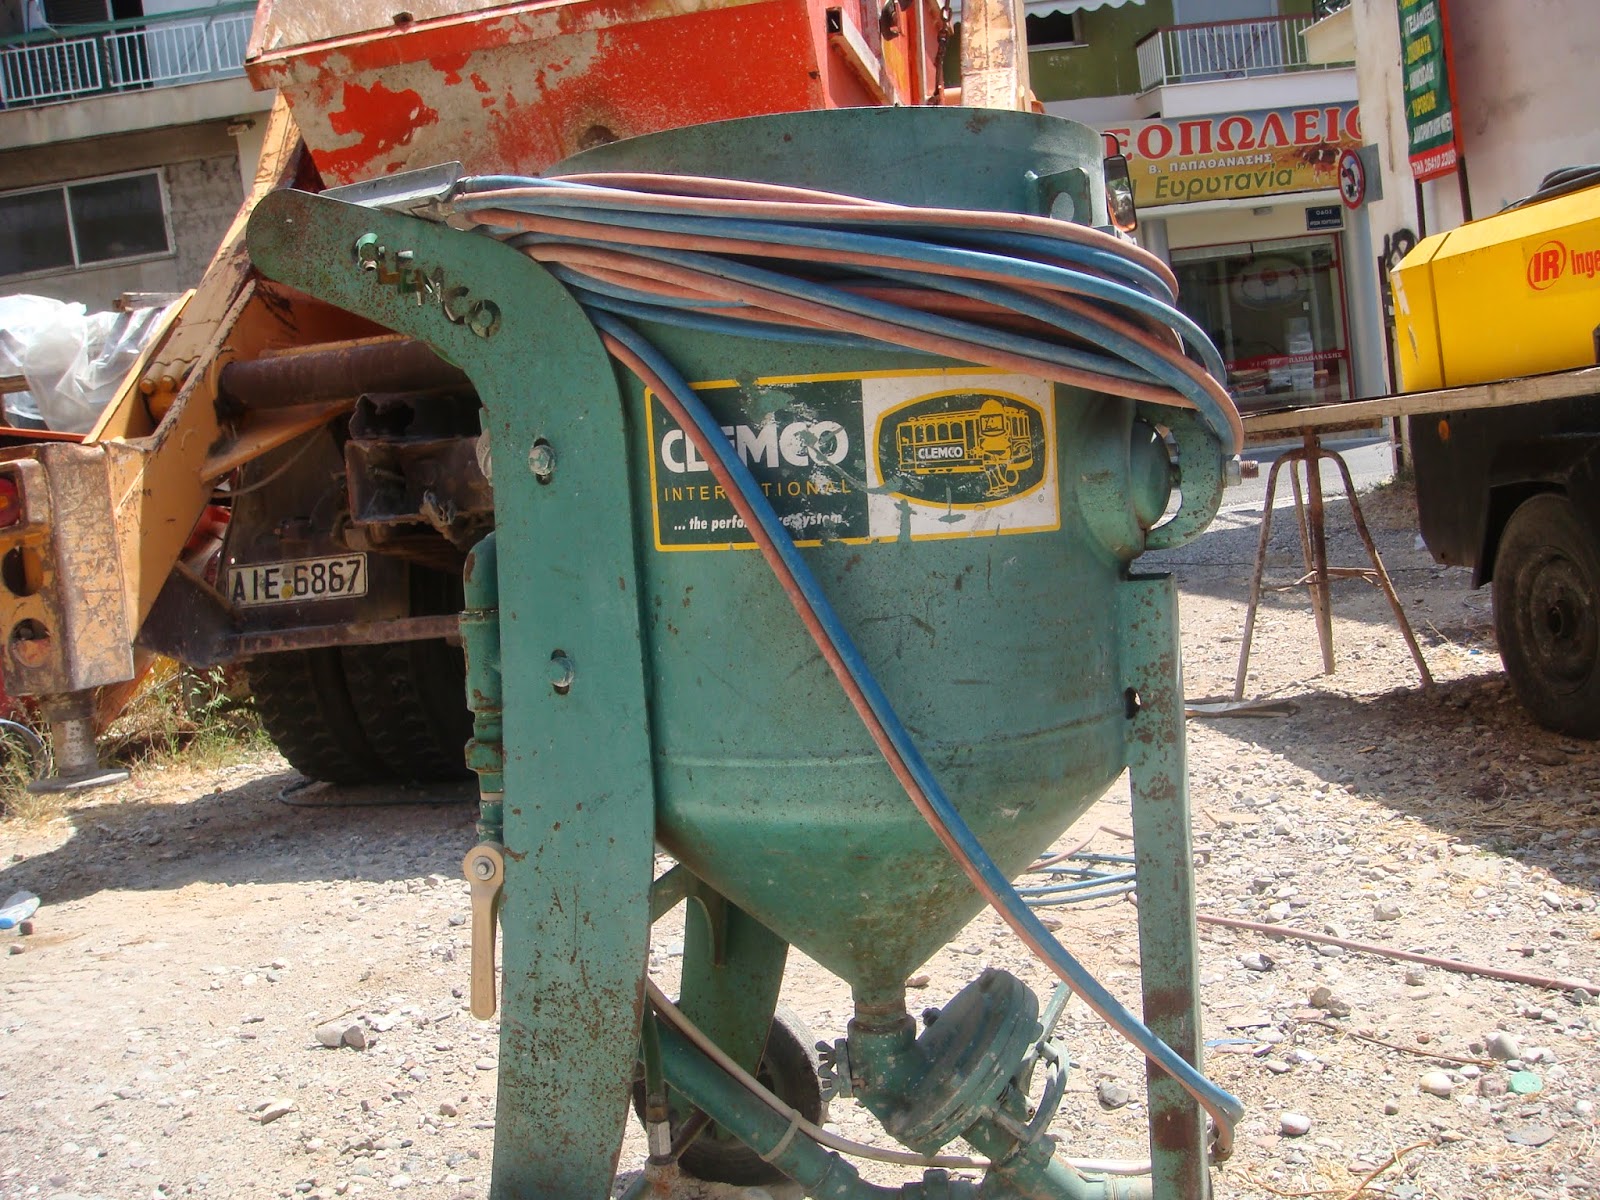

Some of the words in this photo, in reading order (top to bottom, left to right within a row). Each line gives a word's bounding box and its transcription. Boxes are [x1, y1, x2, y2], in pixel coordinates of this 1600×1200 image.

[1169, 153, 1273, 172] ΠΑΠΑΘΑΝΑΣΗΣ
[1533, 249, 1560, 283] IR
[918, 446, 964, 460] CLEMCO
[664, 479, 852, 502] INTERTIONAL
[689, 515, 709, 531] the
